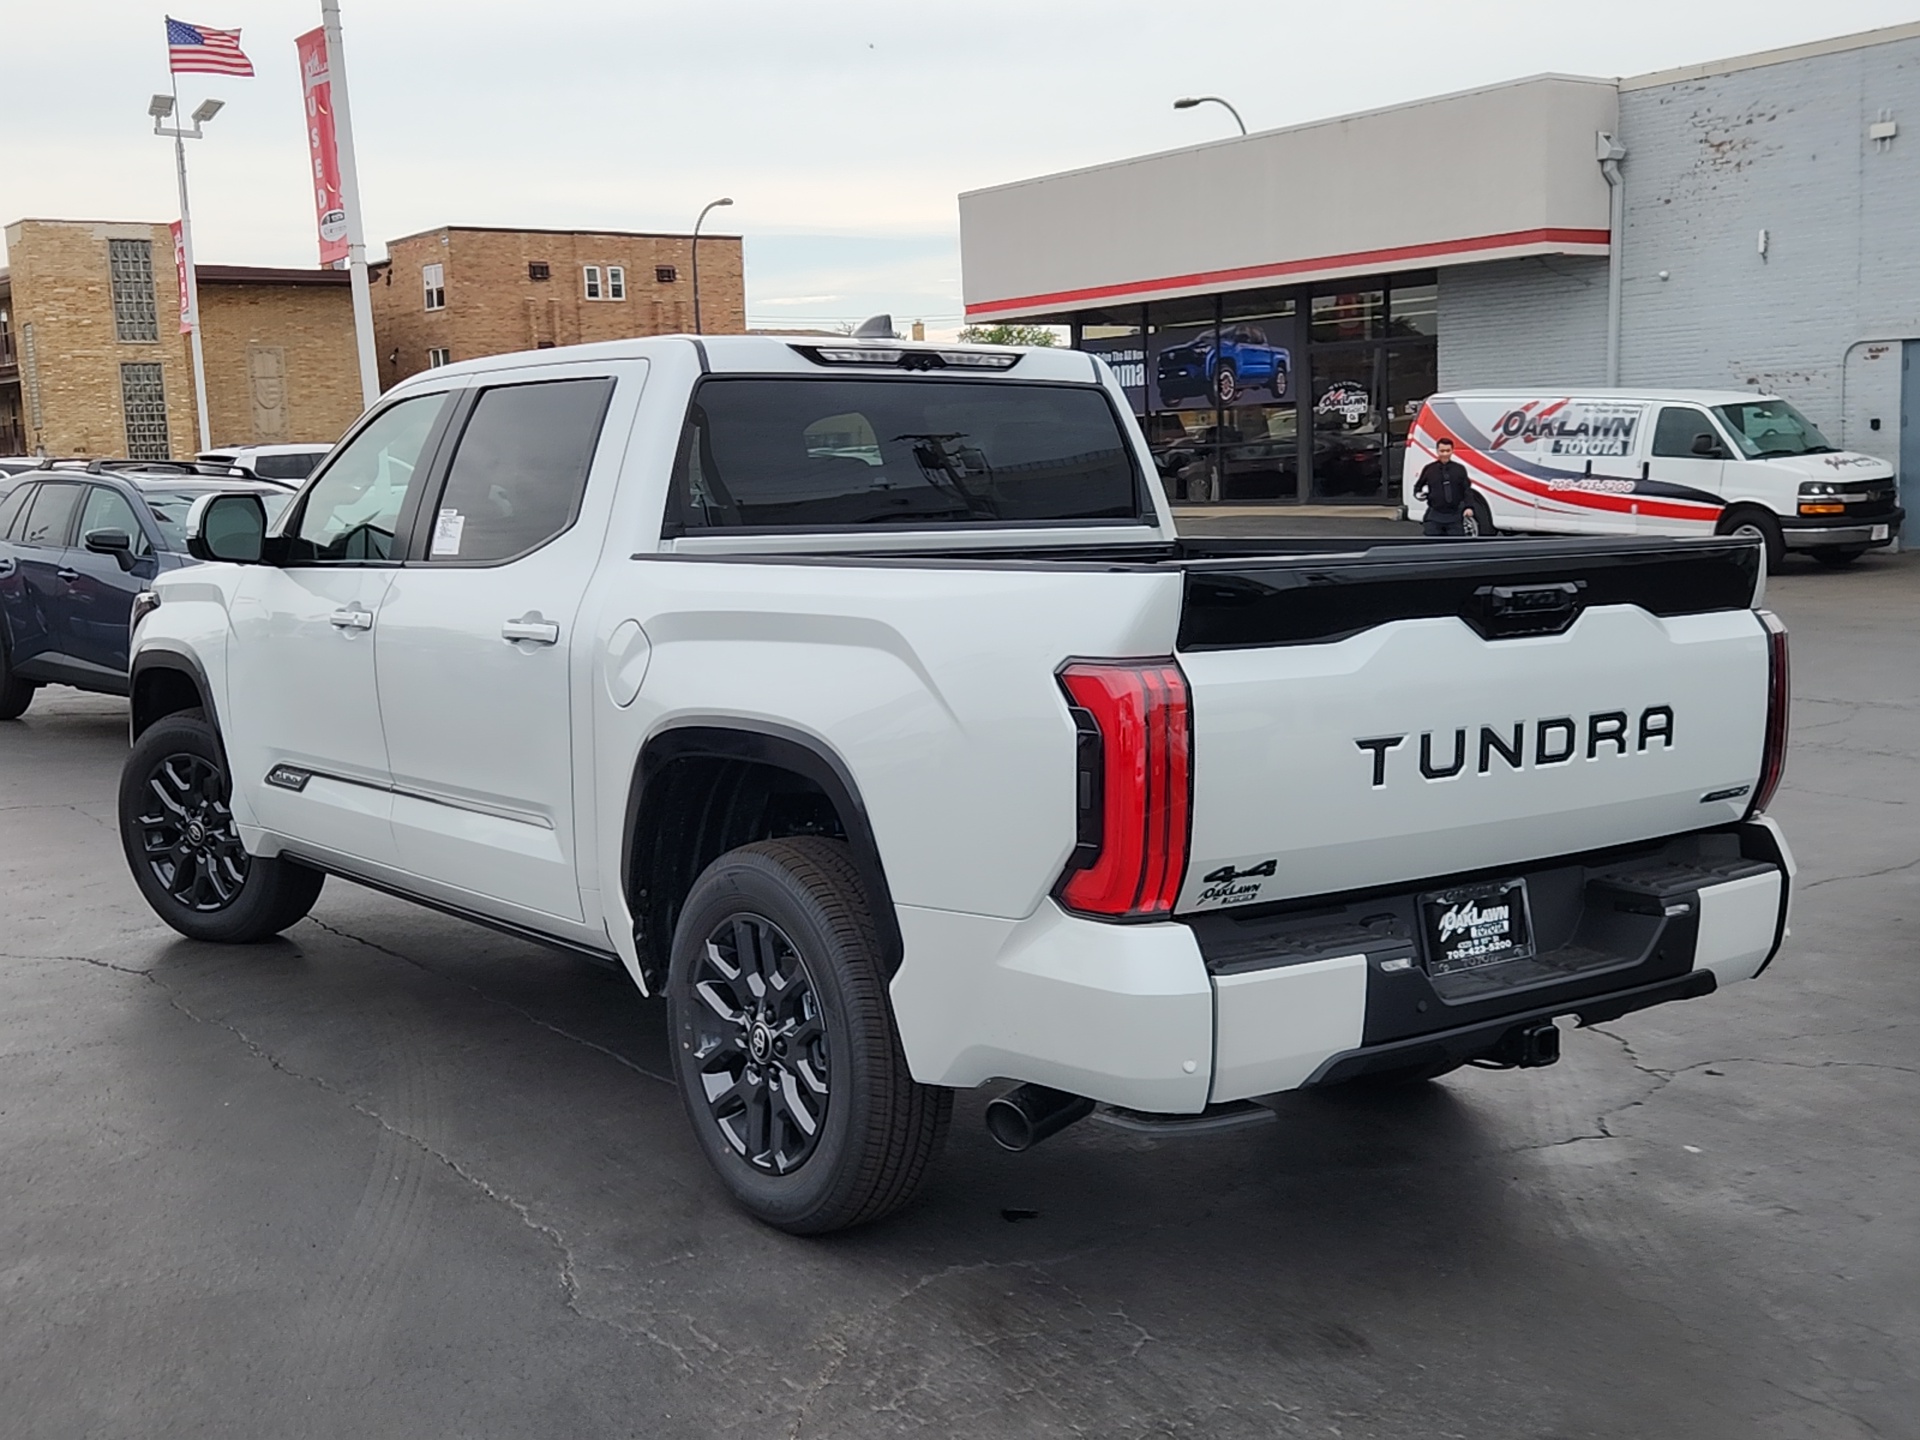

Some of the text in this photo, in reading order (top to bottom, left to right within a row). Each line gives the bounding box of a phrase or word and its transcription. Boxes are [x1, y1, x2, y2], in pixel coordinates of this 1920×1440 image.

[307, 95, 327, 209] USED
[1503, 411, 1636, 437] OAKLAWN
[1559, 440, 1624, 455] TOYOTA
[1549, 479, 1635, 492] 708-423-5200
[1354, 704, 1674, 787] TUNDRA
[1444, 905, 1509, 931] OAKLAWN
[1446, 939, 1512, 960] 708-423-5200
